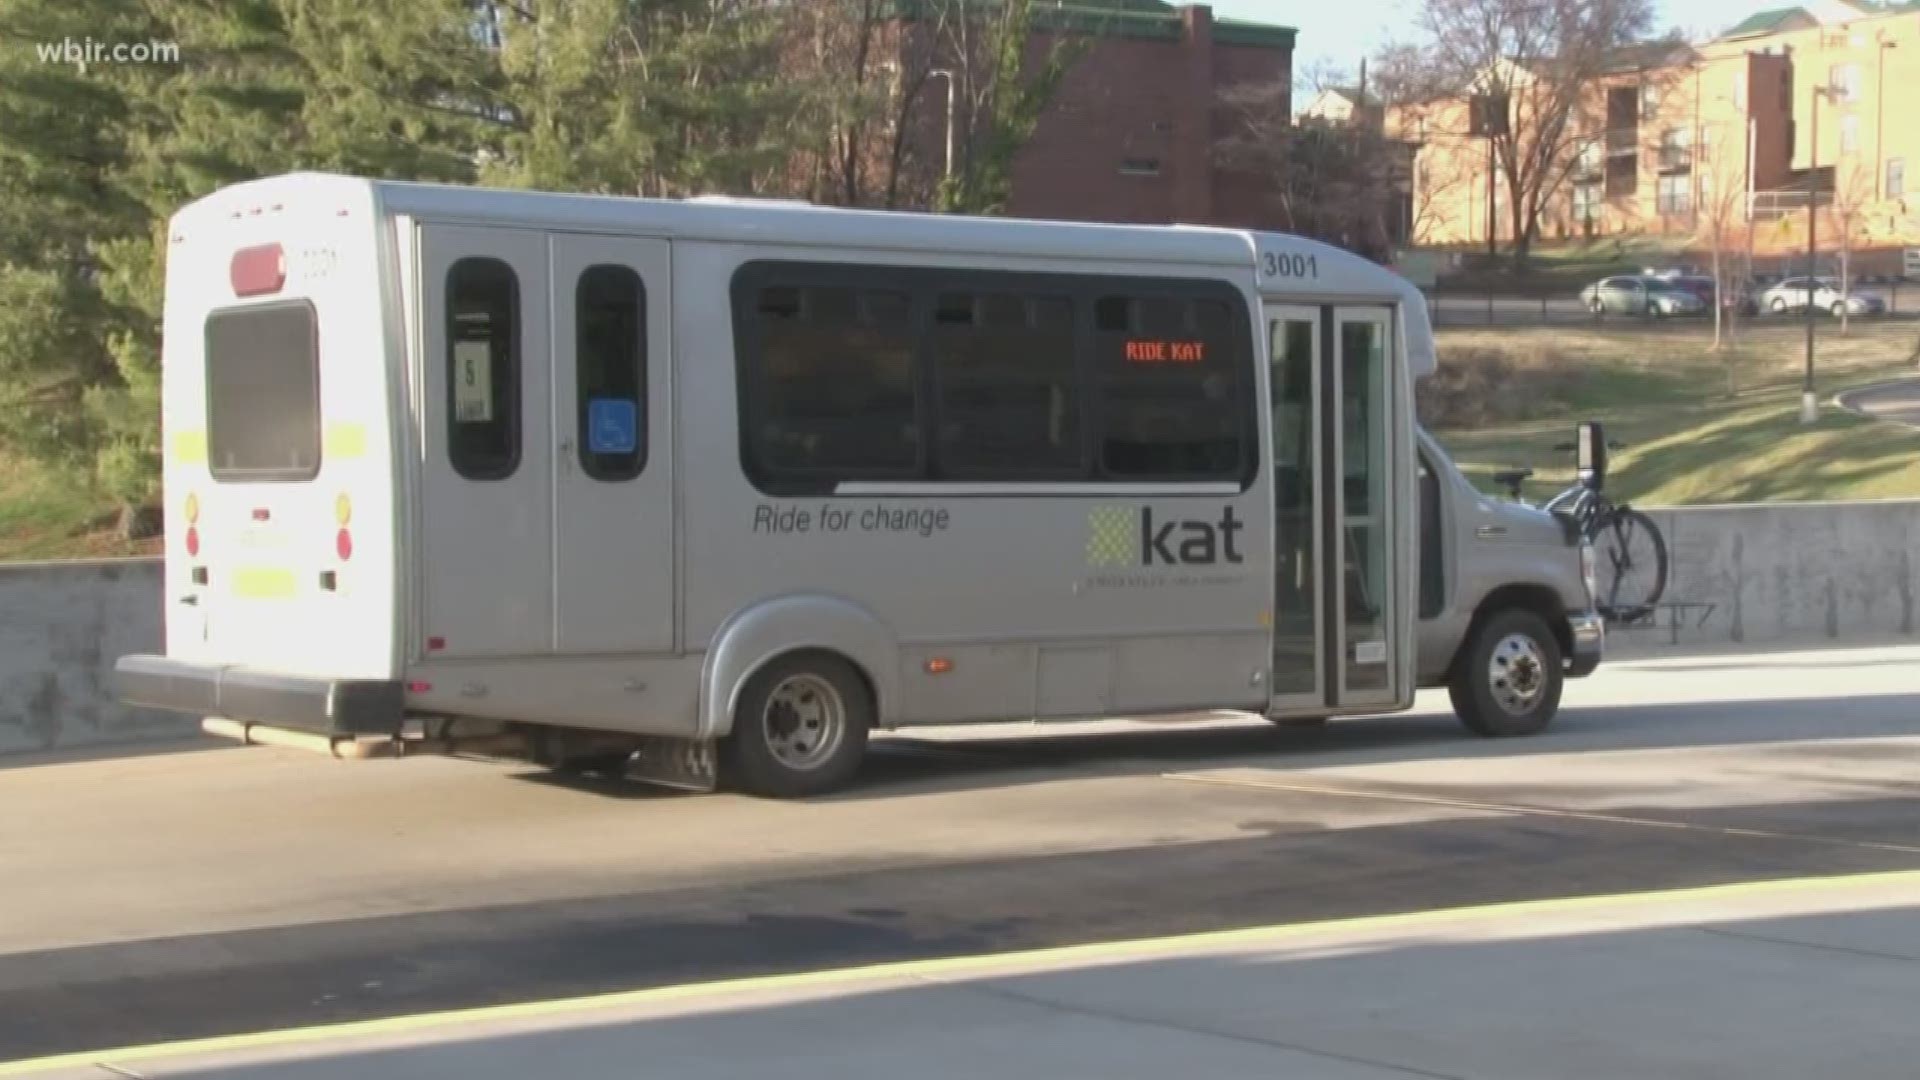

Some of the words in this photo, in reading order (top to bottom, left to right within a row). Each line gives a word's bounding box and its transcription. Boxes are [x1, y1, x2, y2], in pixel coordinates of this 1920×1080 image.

[1263, 252, 1318, 278] 3001
[1126, 341, 1167, 361] RIDE
[1171, 341, 1204, 361] KAT
[753, 504, 811, 533] Ride
[820, 503, 854, 531] for
[860, 503, 950, 537] change
[1141, 505, 1244, 566] kat
